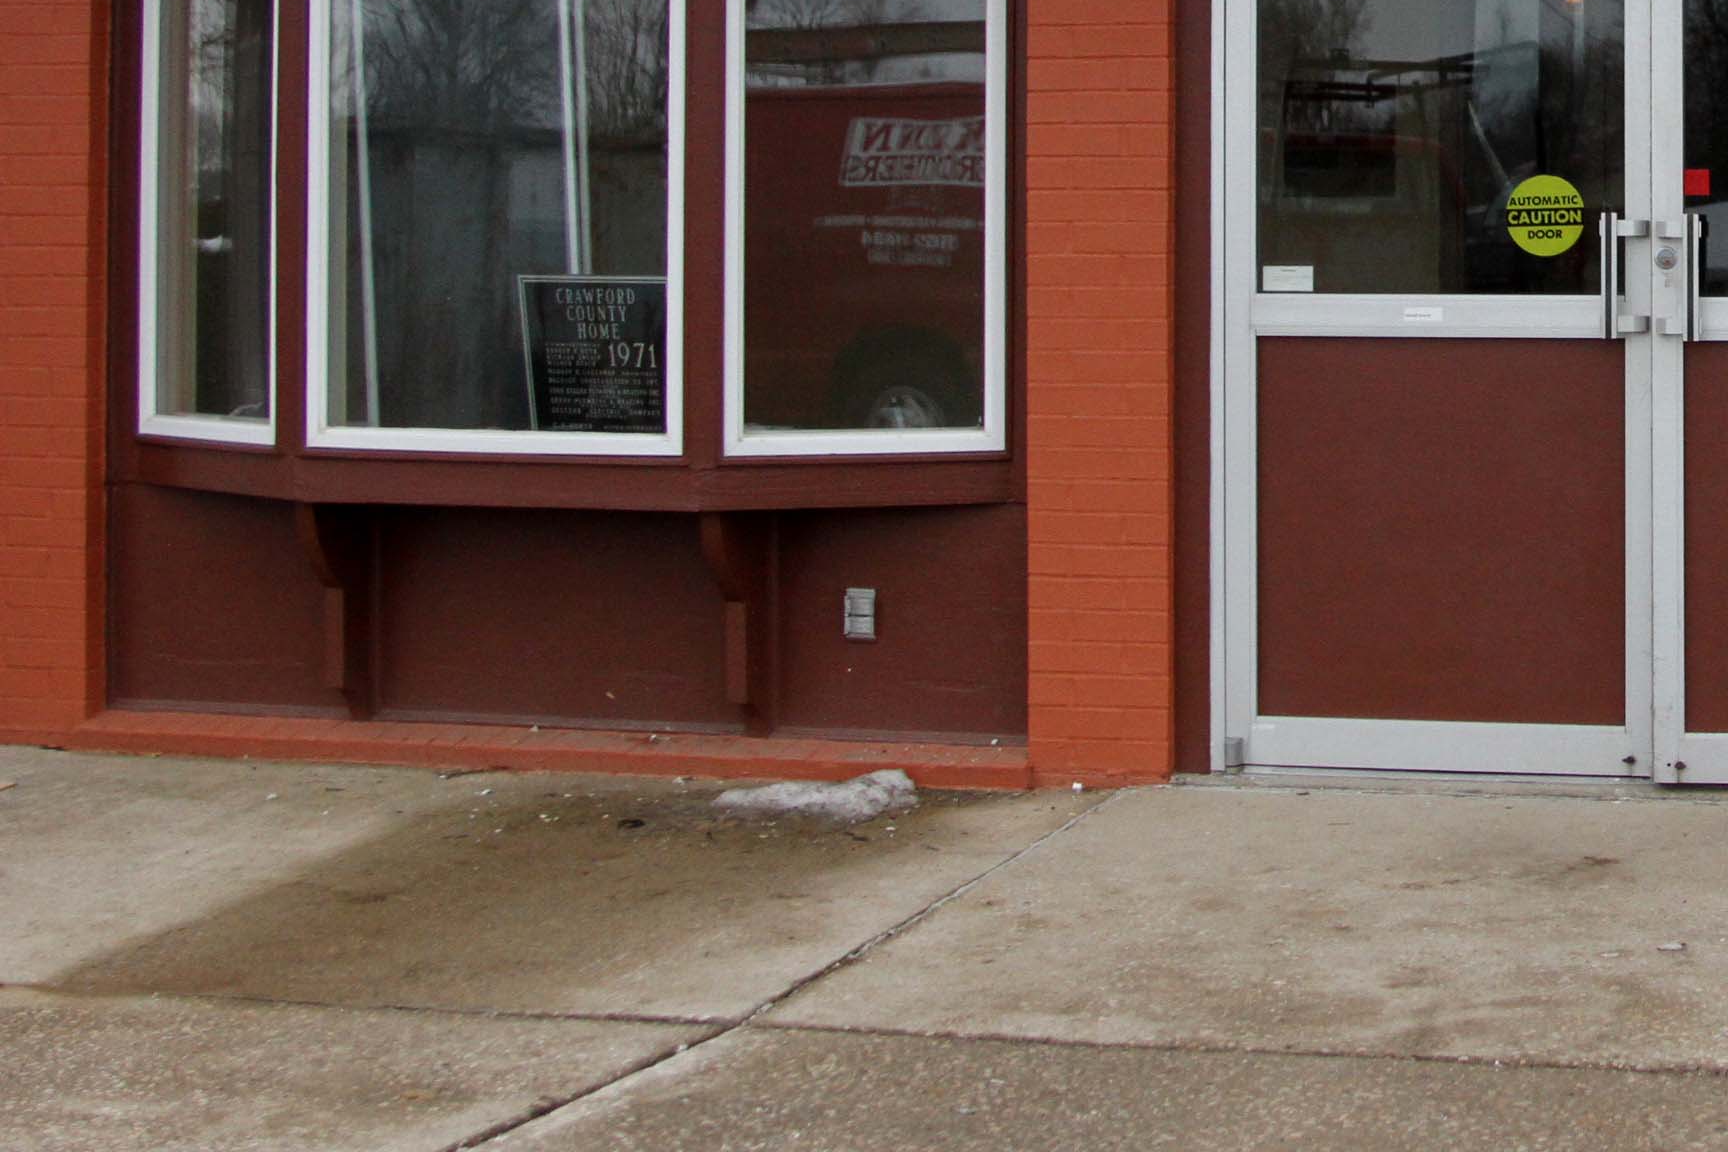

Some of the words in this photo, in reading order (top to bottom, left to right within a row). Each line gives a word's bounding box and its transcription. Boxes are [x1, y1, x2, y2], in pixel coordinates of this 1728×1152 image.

[1509, 195, 1578, 206] AUTOMATIC
[1508, 210, 1582, 225] CAUTION
[1527, 229, 1562, 240] DOOR
[556, 288, 635, 304] CRAWFORD
[566, 305, 627, 321] COUNTY
[577, 323, 620, 340] HOME
[608, 342, 657, 368] 1971
